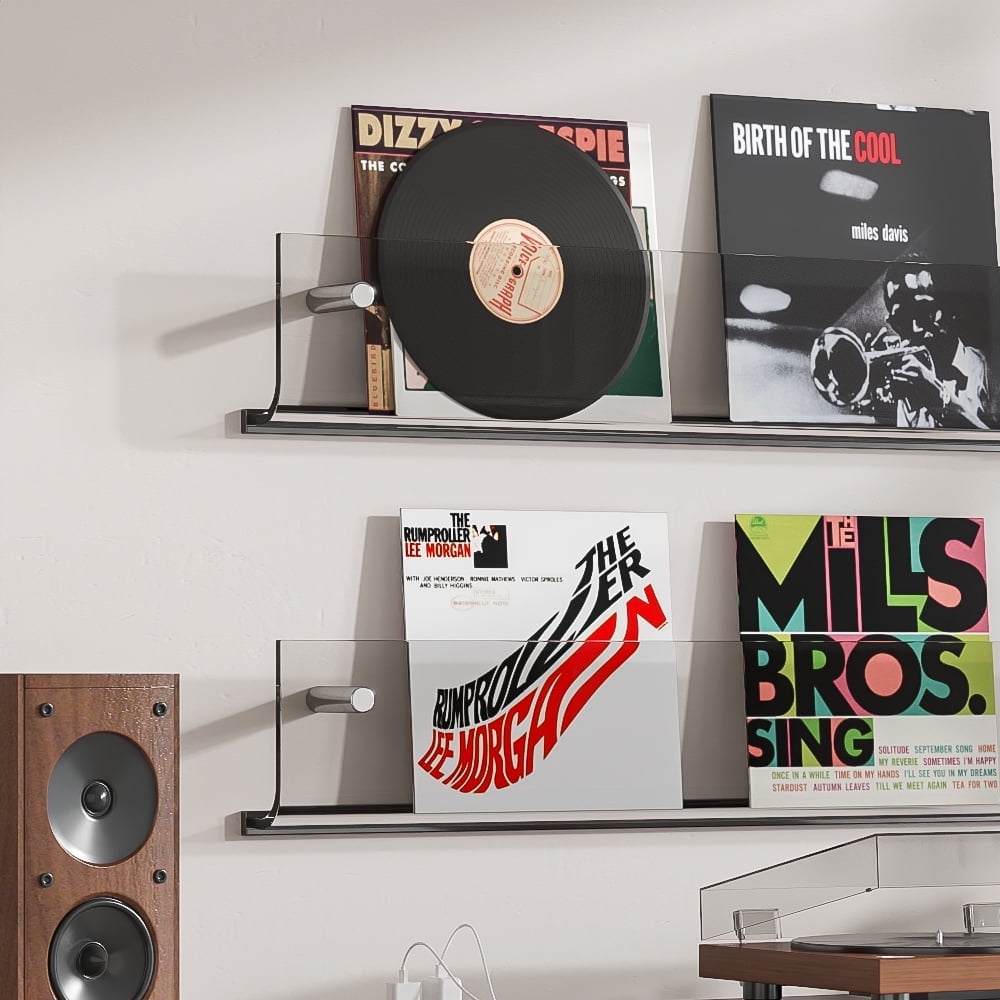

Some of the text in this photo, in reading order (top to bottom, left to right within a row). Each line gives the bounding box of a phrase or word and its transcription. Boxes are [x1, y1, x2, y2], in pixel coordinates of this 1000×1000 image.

[732, 122, 902, 165] BIRTH OF THE COOL
[360, 159, 385, 173] THE
[851, 222, 909, 243] miles davis
[488, 277, 517, 317] GRAPH
[370, 345, 379, 408] BLUEBIRD
[403, 526, 471, 543] RUMPROLLER
[449, 512, 471, 528] THE
[826, 516, 857, 547] THE
[405, 543, 472, 558] LEE MORGAN
[572, 525, 637, 598] THE
[736, 515, 988, 632] MILLS
[442, 584, 668, 794] MORGAN
[741, 634, 987, 716] BROS.
[418, 729, 454, 780] LEE
[747, 717, 875, 767] SING
[878, 744, 997, 755] SOLITUDE SEPTEMBER SONG HOME
[771, 768, 997, 780] ONCE IN A WHILE TIME ON MY HANDS I'LL SEE YOU IN MY DREAMS
[878, 756, 997, 766] MY REVERIE SOMETIMES I'M HAPPY
[772, 780, 998, 792] STARDUST AUTUMN LEAVES TILL WE MEET AGAIN TEA FOR TWO
